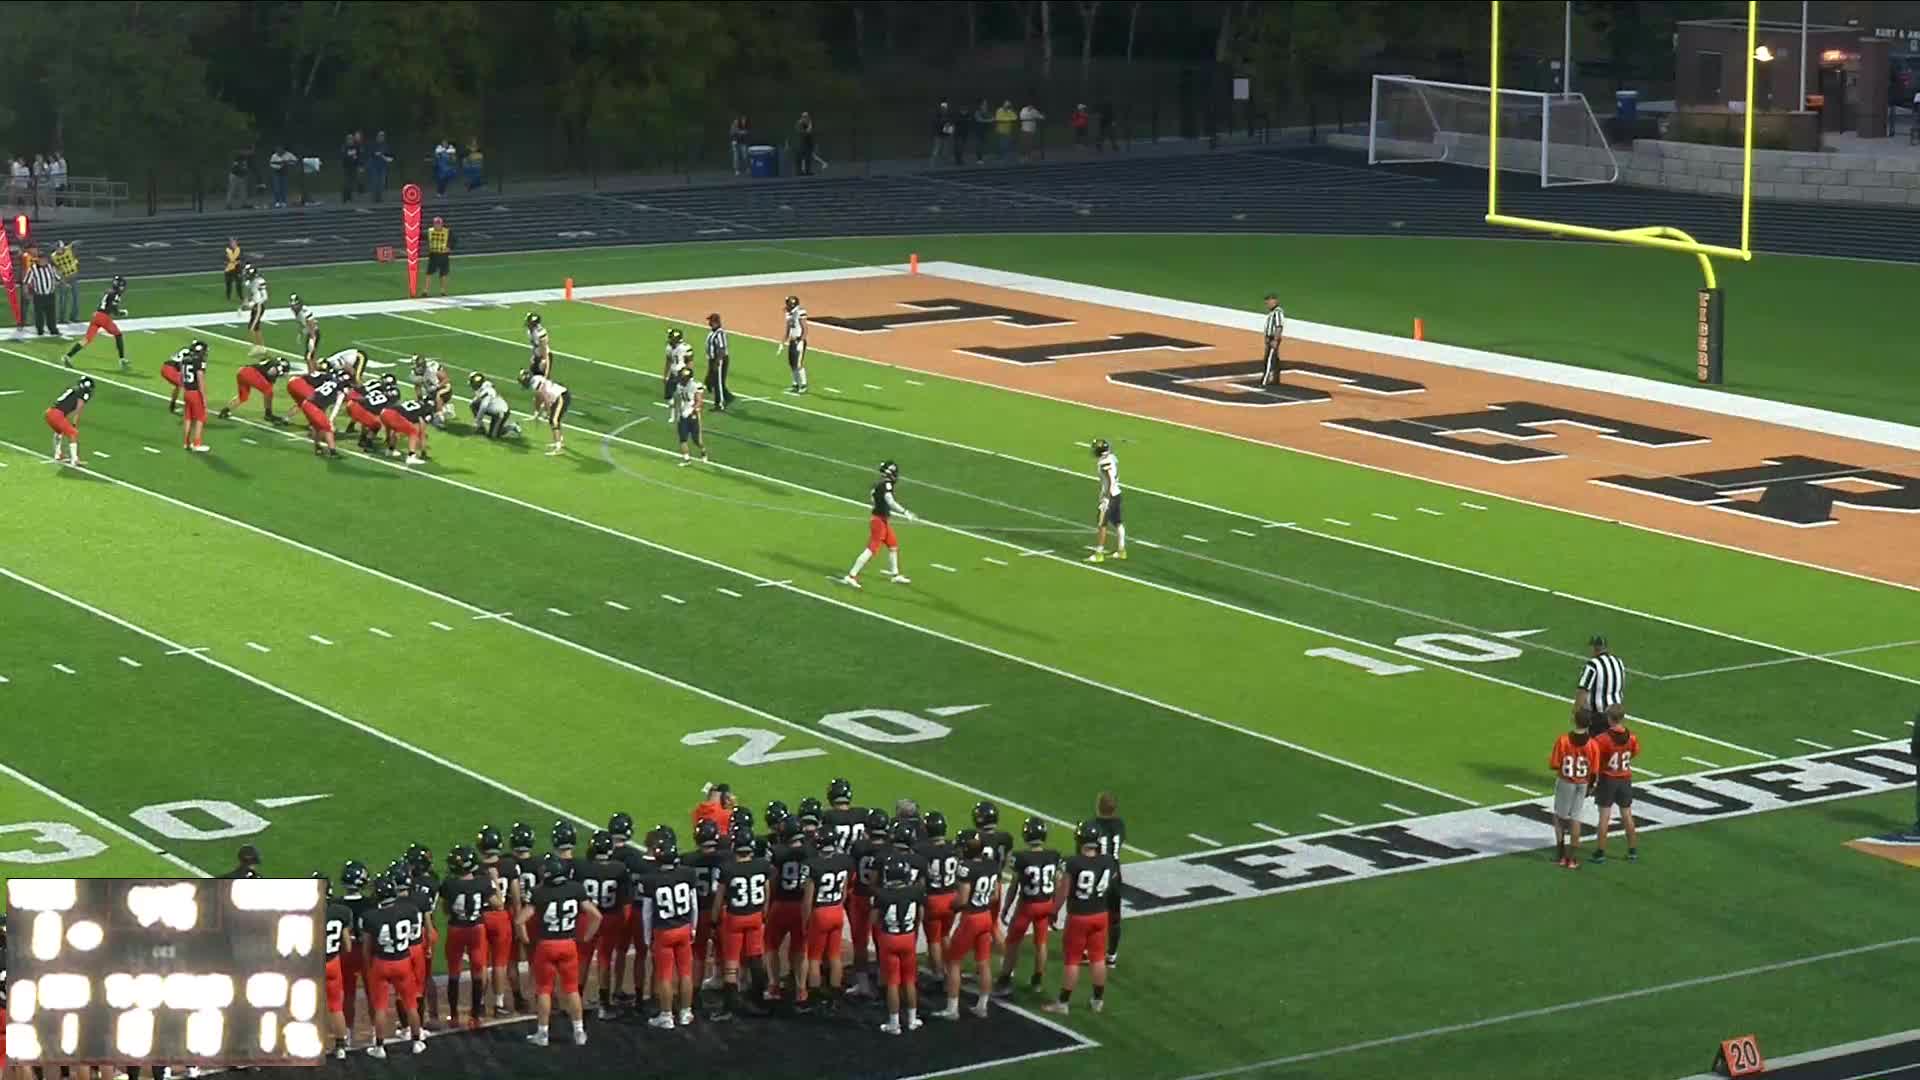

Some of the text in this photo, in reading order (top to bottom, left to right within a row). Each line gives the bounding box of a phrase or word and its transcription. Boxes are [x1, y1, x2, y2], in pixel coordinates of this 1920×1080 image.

[1304, 632, 1524, 676] 10
[679, 708, 953, 767] 20
[1562, 755, 1589, 778] 85
[1608, 751, 1633, 772] 42
[0, 799, 272, 864] 30
[656, 882, 691, 920] 99
[730, 873, 767, 908] 36
[1075, 867, 1111, 900] 94
[543, 898, 579, 933] 42
[378, 919, 411, 955] 49
[1730, 1040, 1758, 1070] 20
